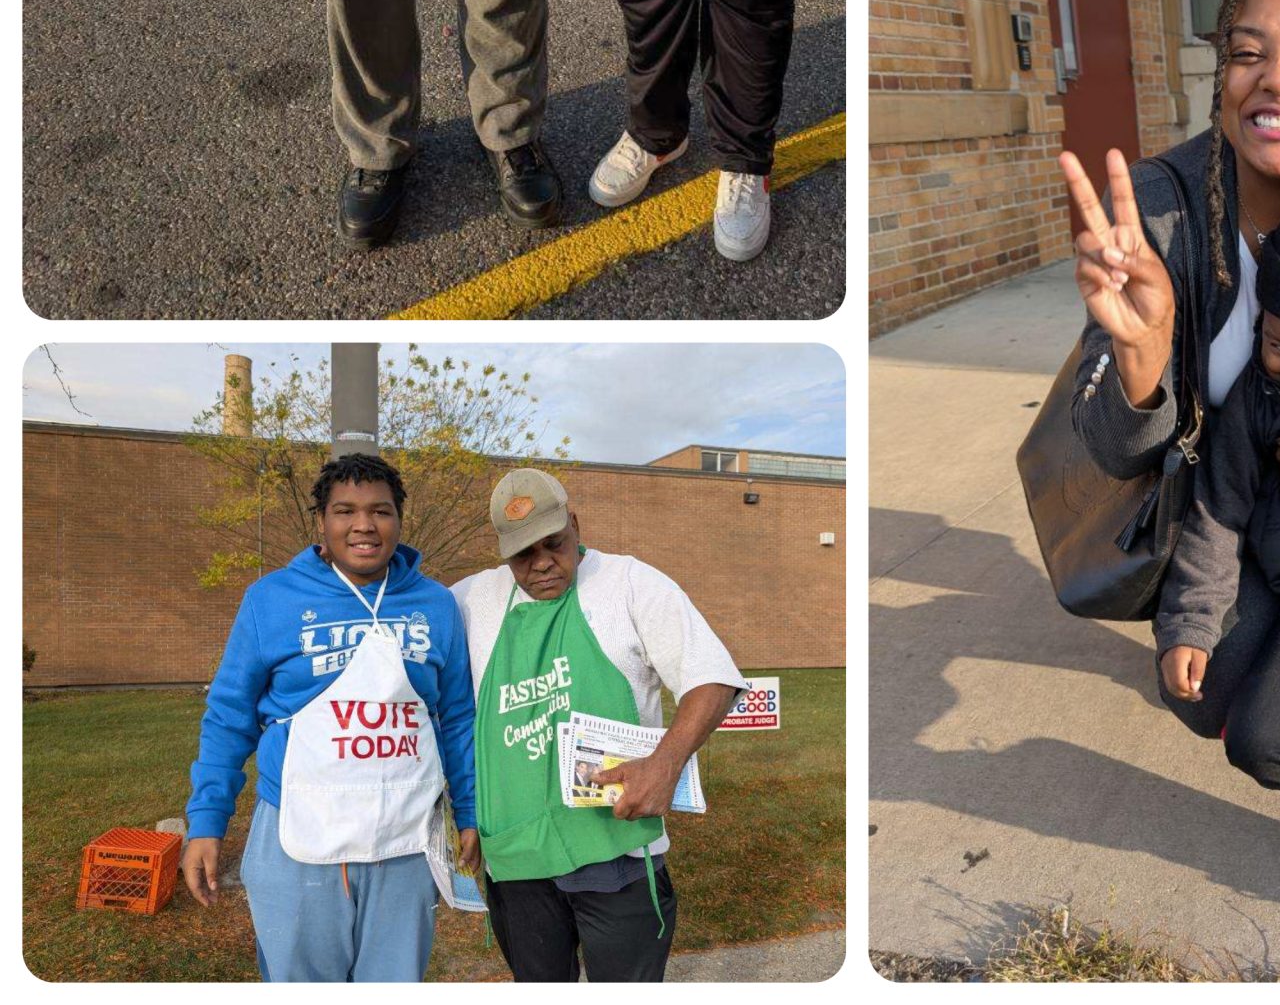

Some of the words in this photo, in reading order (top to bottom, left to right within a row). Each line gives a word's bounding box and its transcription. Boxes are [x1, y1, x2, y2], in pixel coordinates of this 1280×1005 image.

[742, 690, 776, 702] OOD
[737, 702, 776, 714] GOOD
[330, 700, 419, 730] VOTE
[722, 717, 753, 726] PROBATE
[754, 716, 776, 724] JUDGE
[331, 734, 418, 759] TODAY
[98, 851, 149, 863] Bareman's
